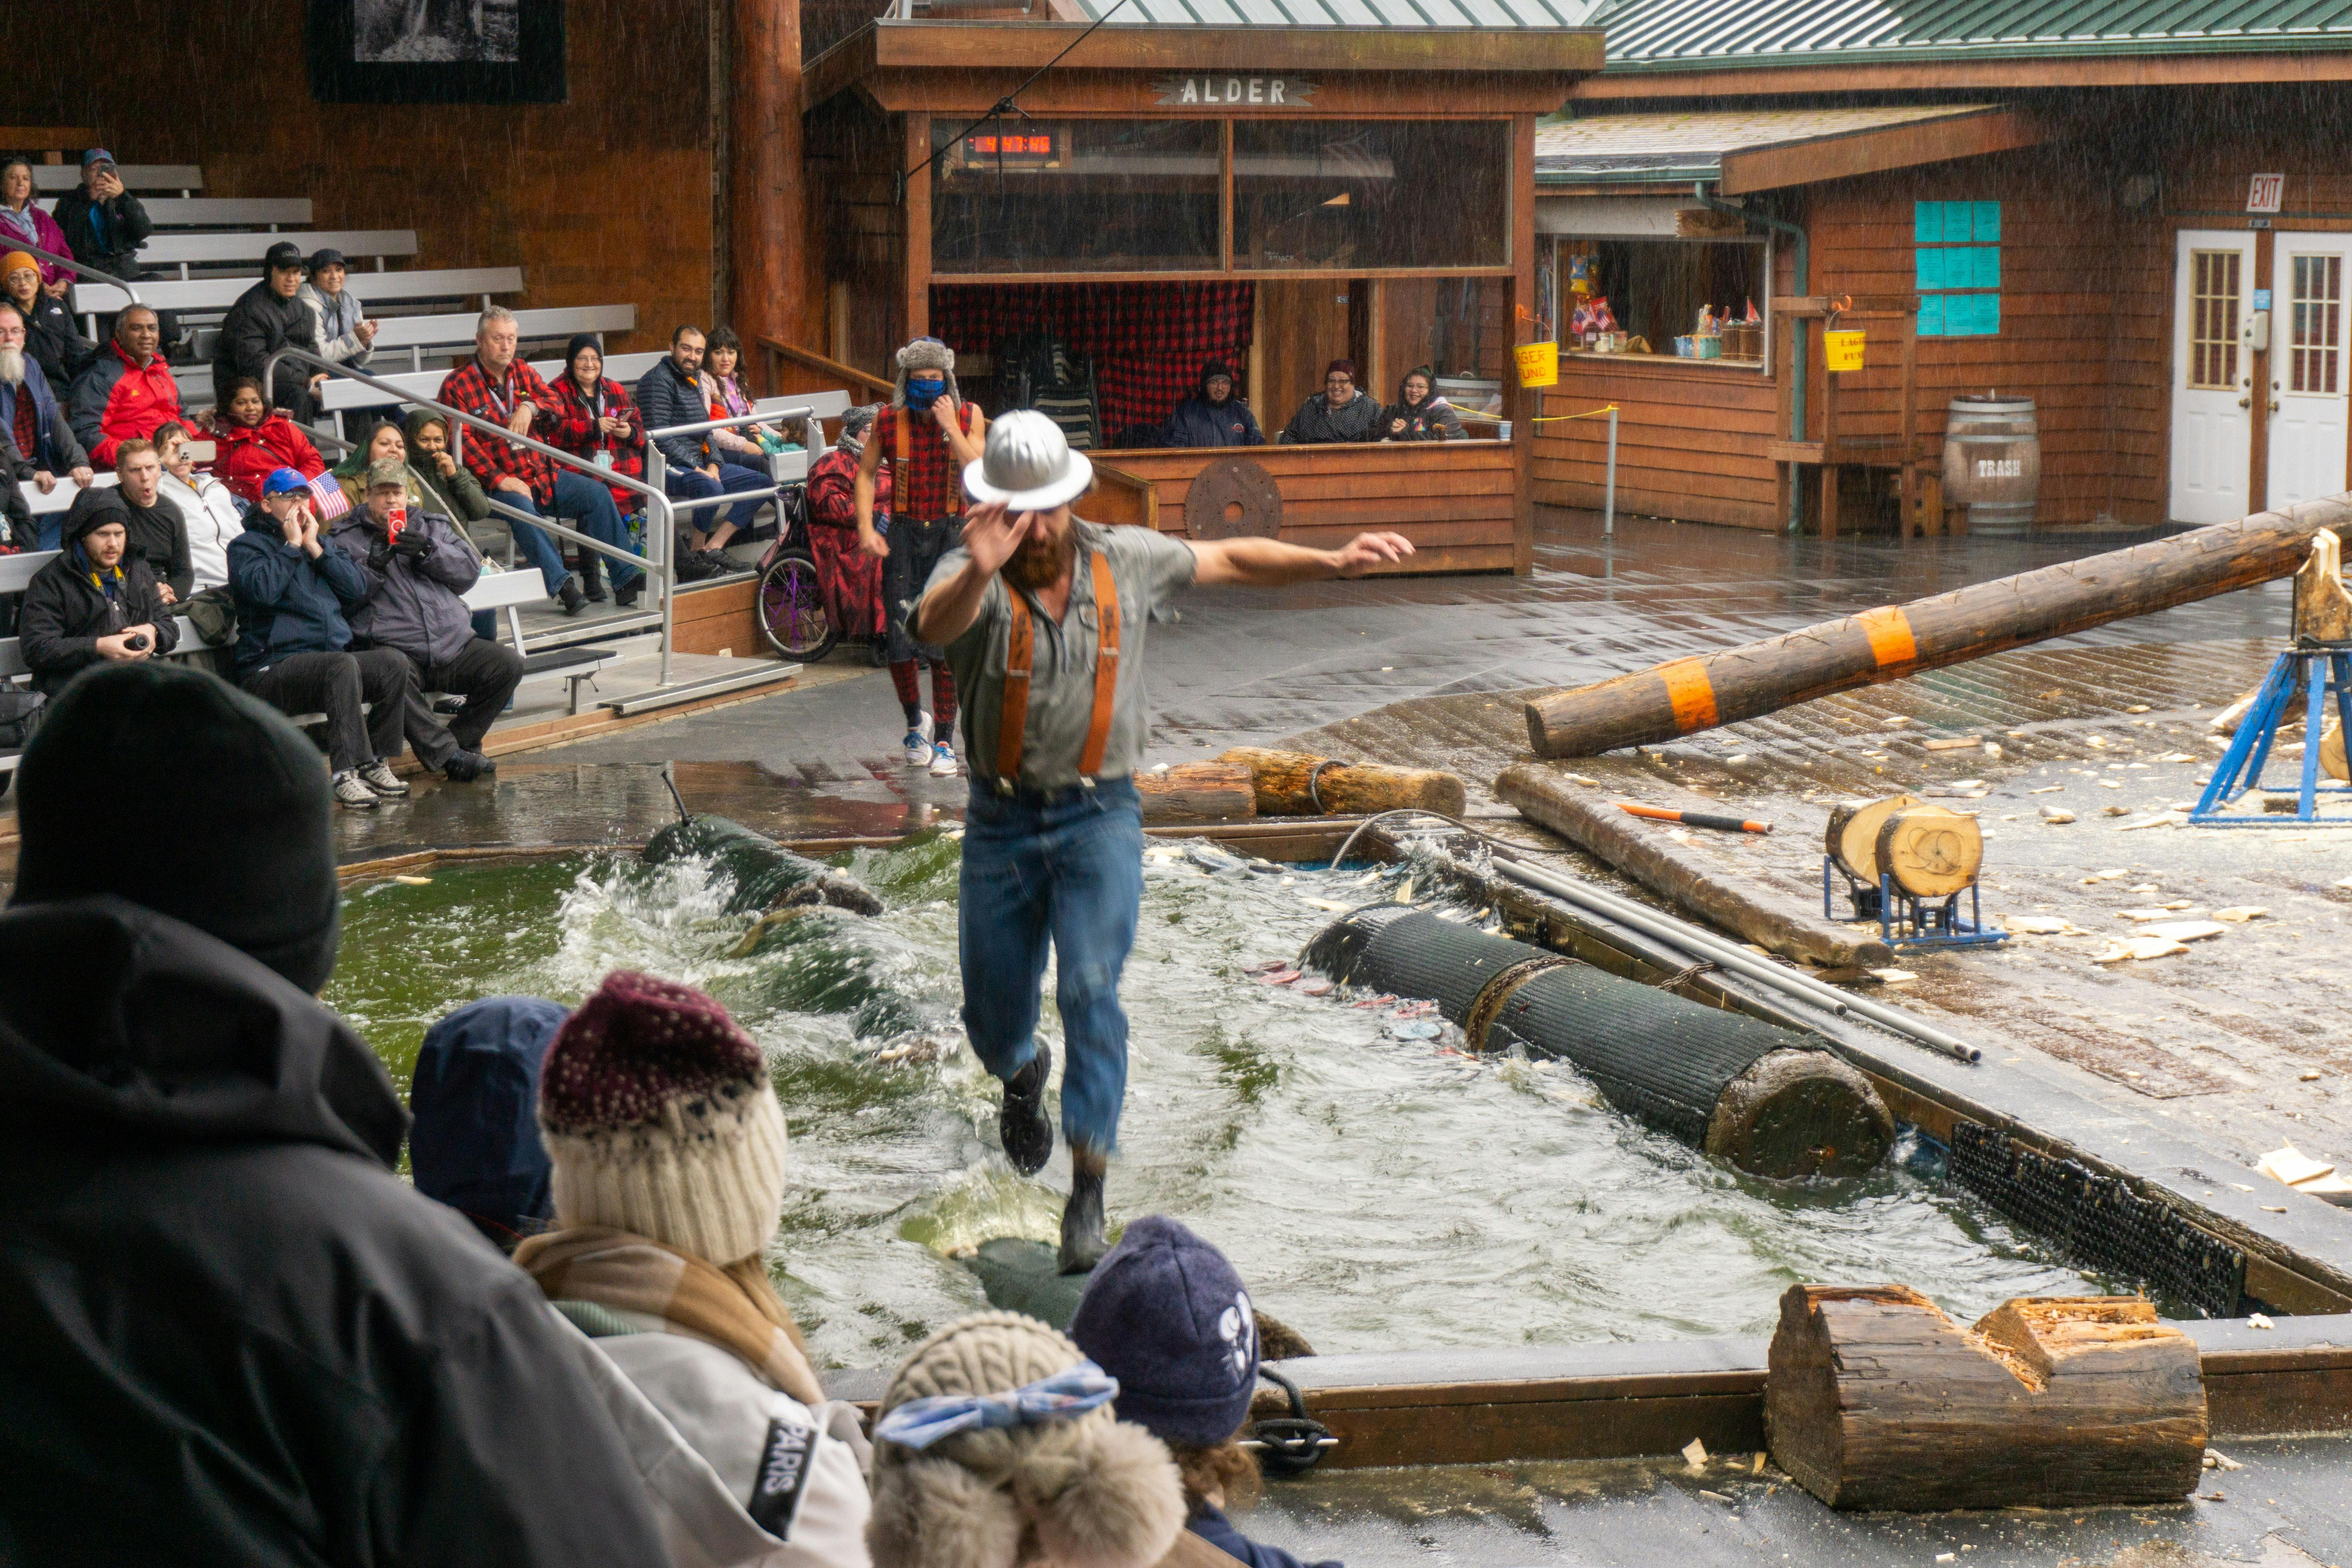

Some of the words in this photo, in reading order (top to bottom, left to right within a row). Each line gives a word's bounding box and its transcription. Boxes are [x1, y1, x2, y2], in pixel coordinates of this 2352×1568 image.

[1182, 78, 1285, 103] ALDER
[2251, 177, 2280, 207] EXIT
[1979, 460, 2020, 477] TRASH
[763, 1421, 809, 1495] PARIS
